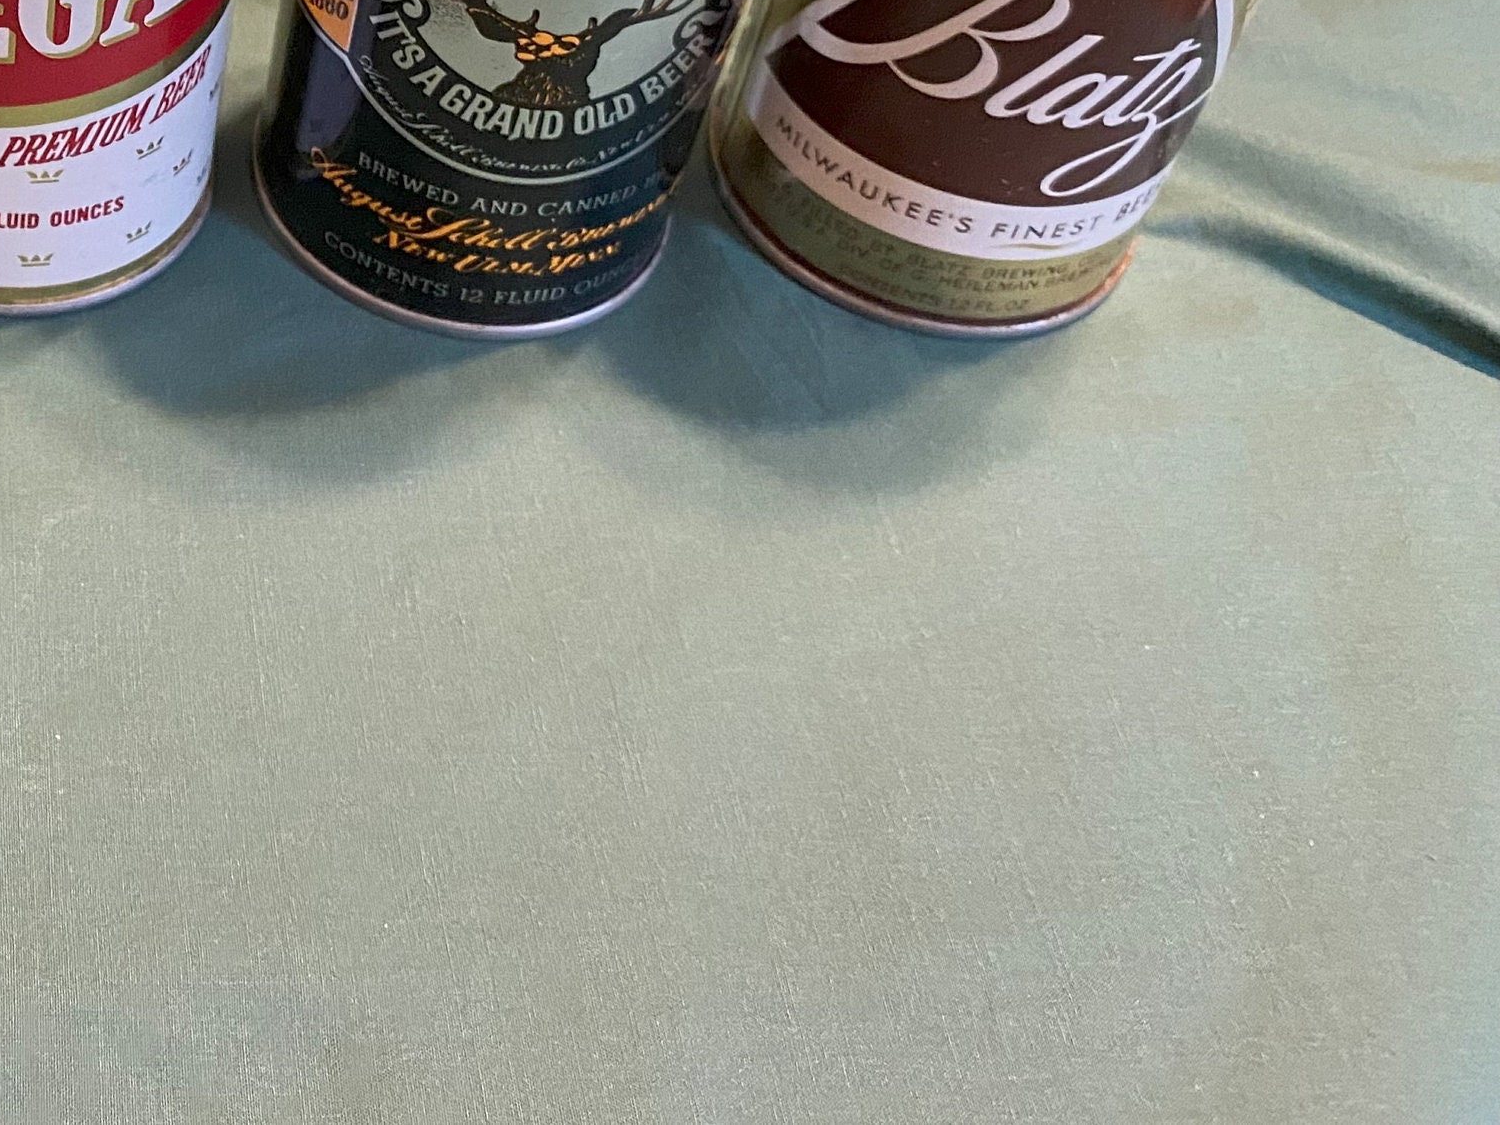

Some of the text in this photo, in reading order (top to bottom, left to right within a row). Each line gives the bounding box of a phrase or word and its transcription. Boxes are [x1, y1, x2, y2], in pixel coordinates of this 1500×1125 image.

[148, 43, 212, 125] BEER
[368, 10, 427, 71] IT'S
[409, 65, 451, 99] A
[437, 83, 565, 142] GRAND
[573, 91, 637, 137] OLD
[639, 33, 715, 105] BEER
[49, 195, 126, 228] OUNCES
[358, 151, 460, 206] BREWED
[470, 196, 528, 217] AND
[537, 183, 638, 217] CANNED
[774, 116, 975, 235] MILWAUKEE'S
[990, 211, 1108, 240] FINEST
[323, 230, 450, 299] CONTENTS
[459, 286, 486, 305] 12
[493, 285, 568, 306] FLUID
